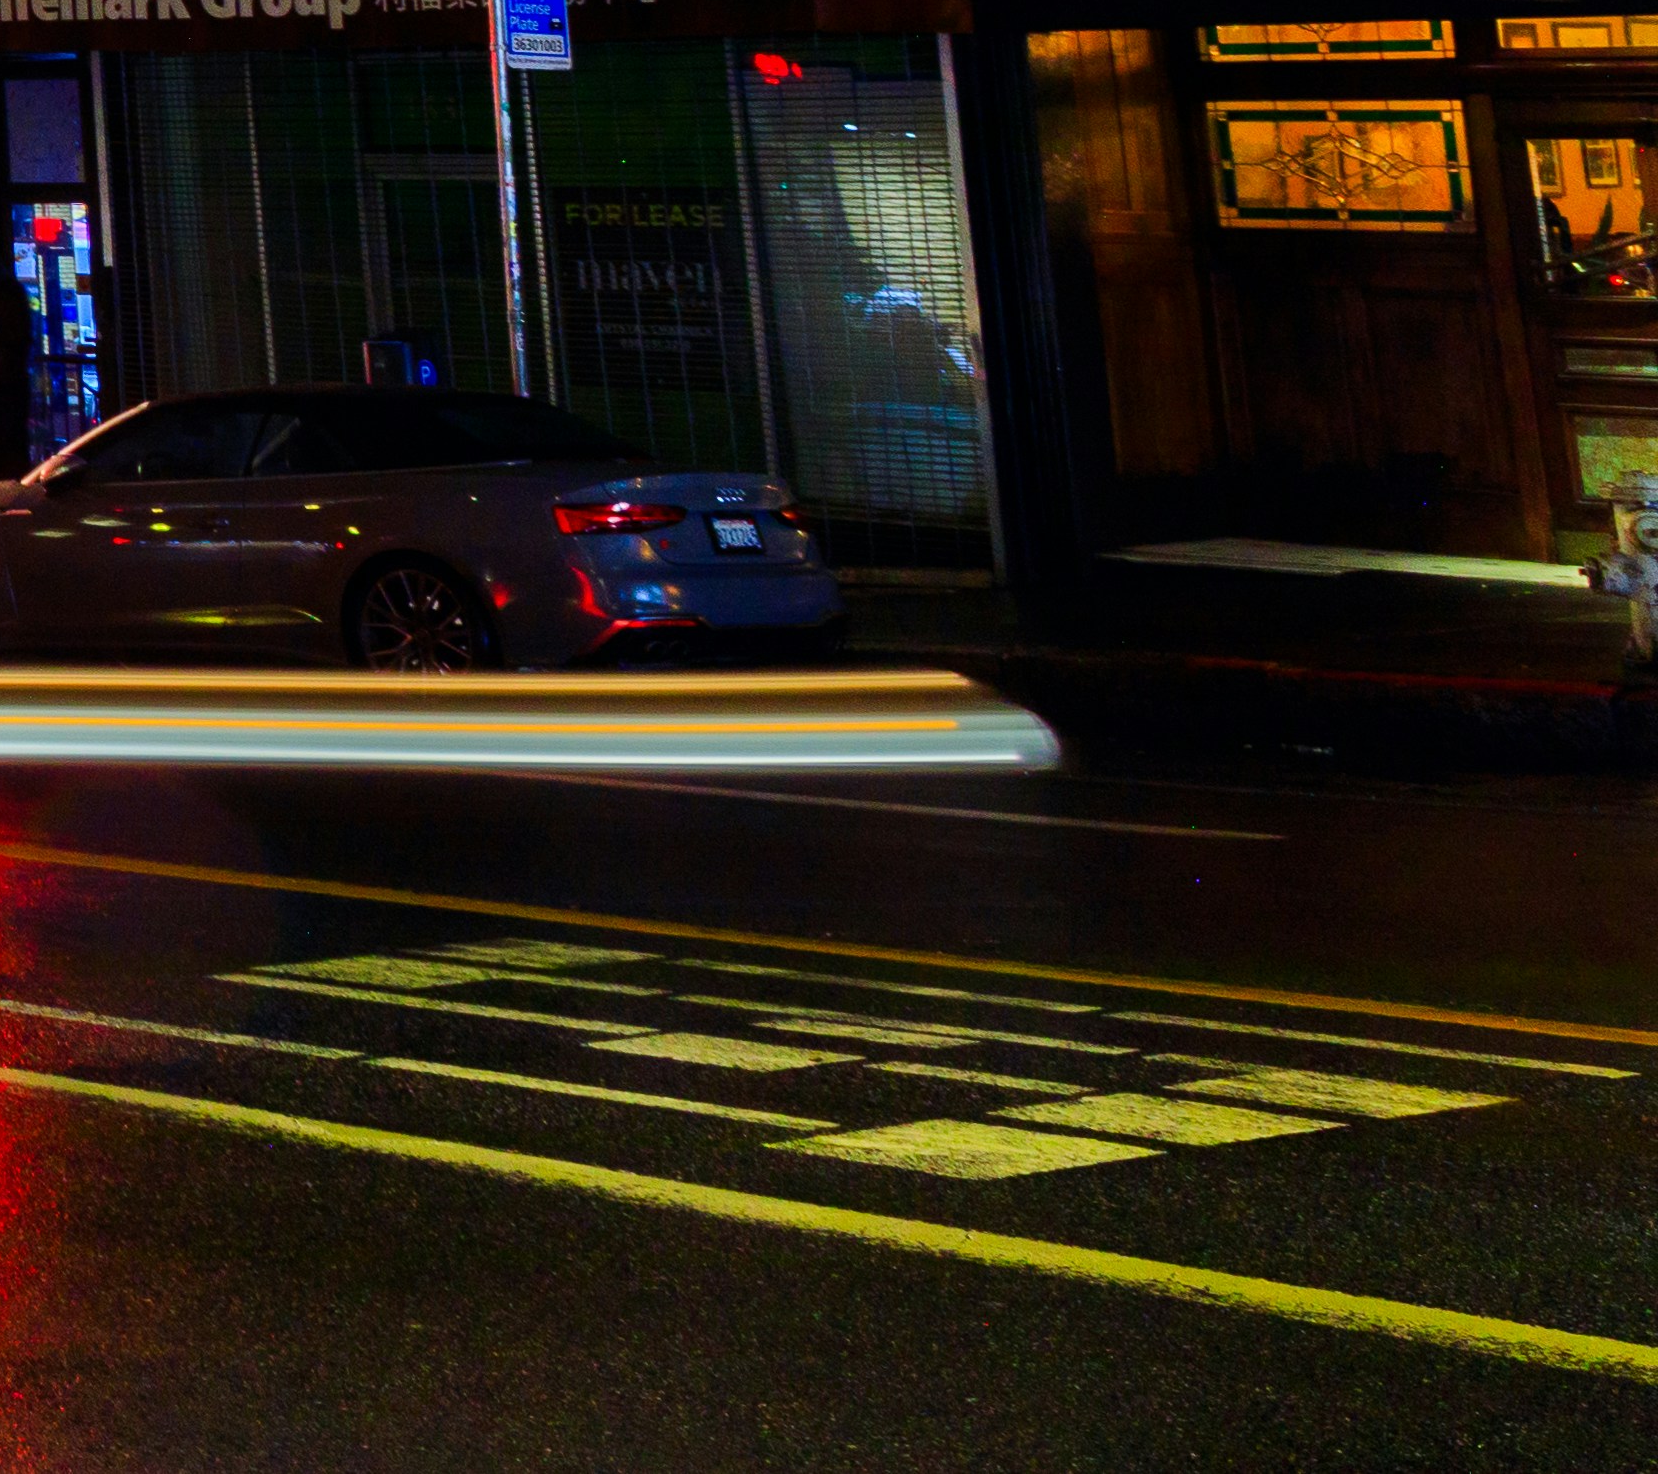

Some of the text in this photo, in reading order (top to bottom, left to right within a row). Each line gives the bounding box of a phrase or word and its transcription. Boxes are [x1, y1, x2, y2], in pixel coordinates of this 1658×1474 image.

[509, 0, 551, 15] License
[510, 17, 539, 31] Plate
[512, 36, 563, 53] 36301003
[563, 202, 726, 228] FOR LEASE
